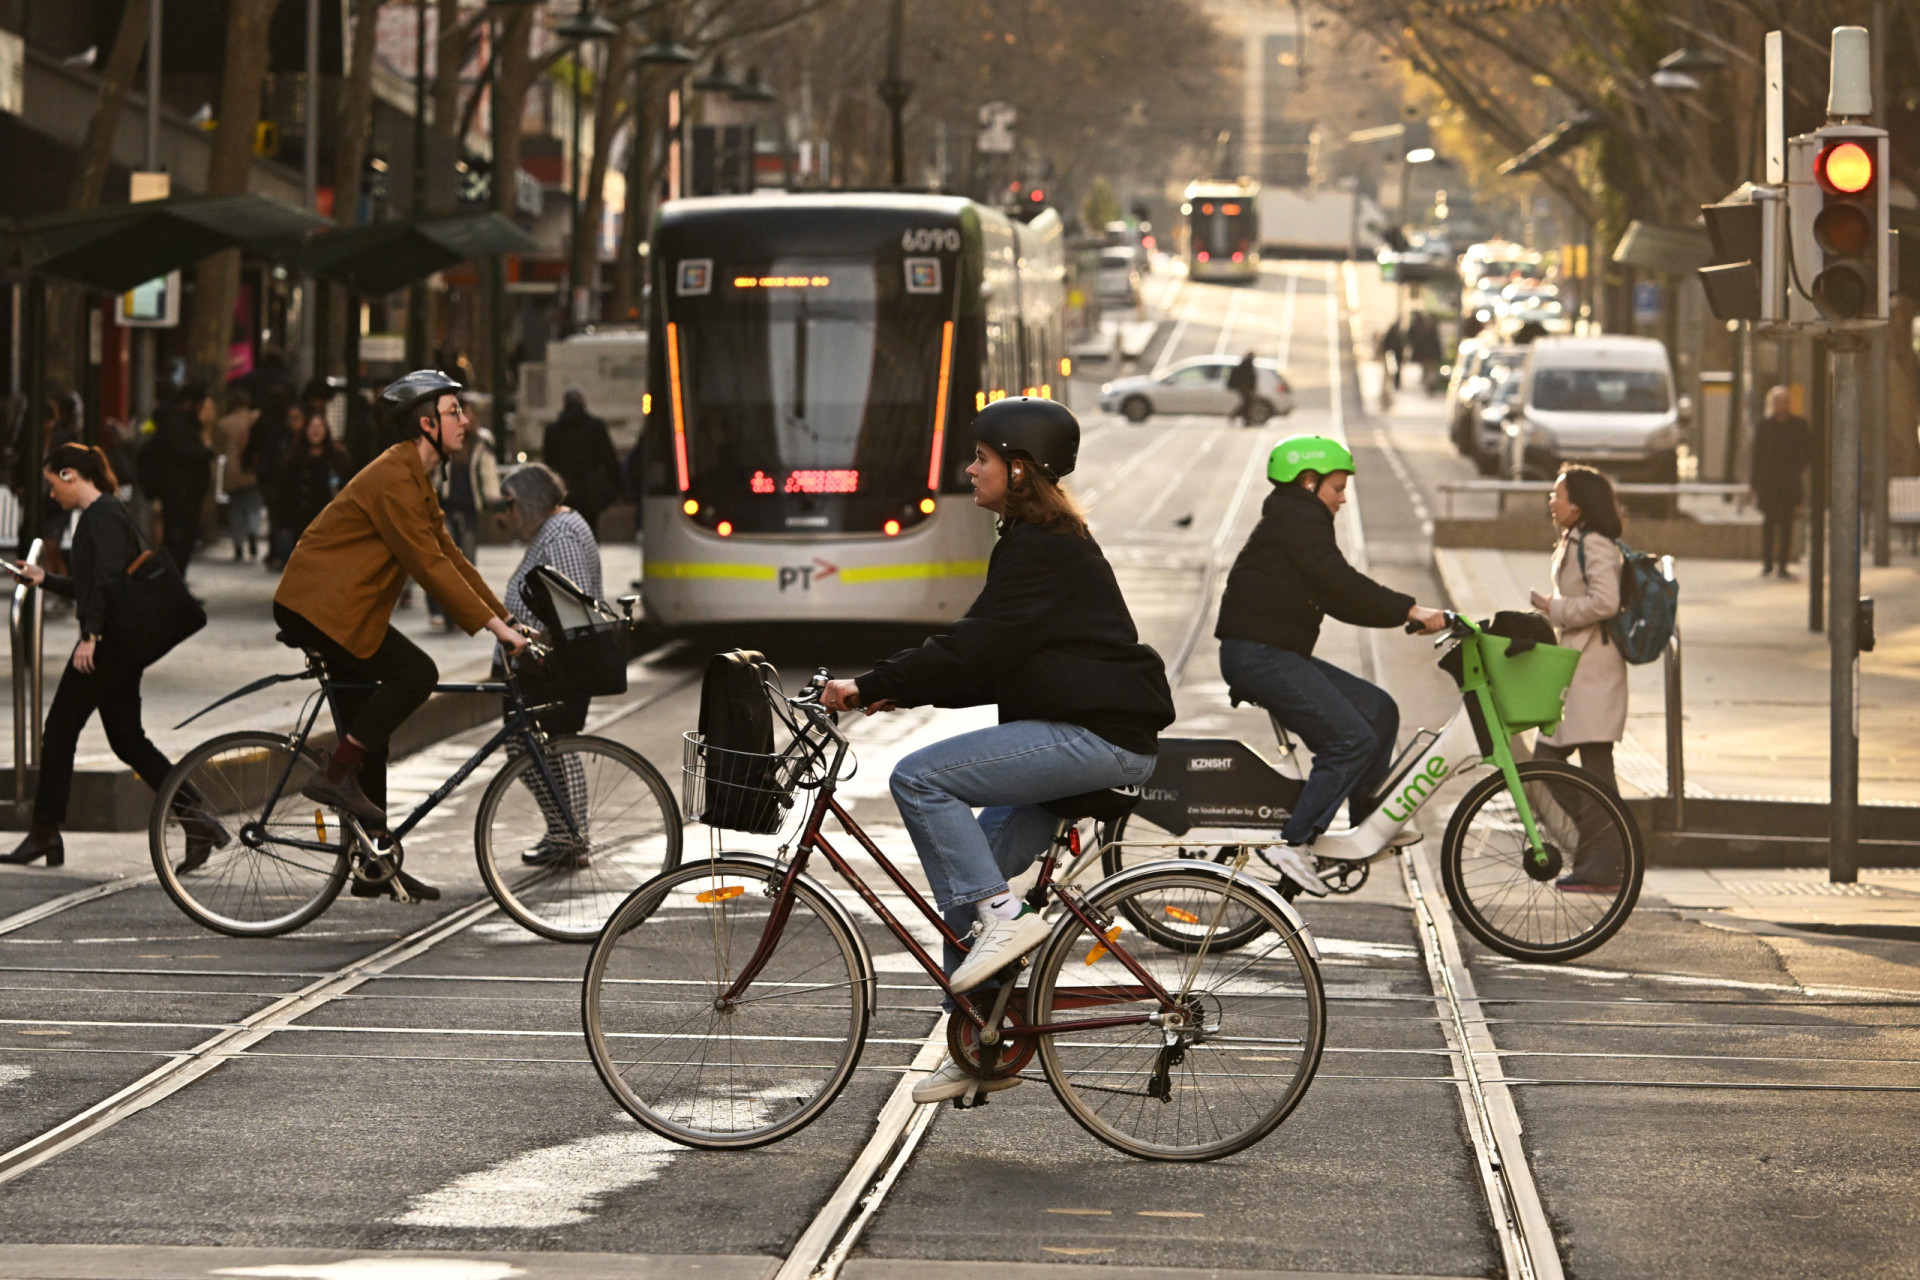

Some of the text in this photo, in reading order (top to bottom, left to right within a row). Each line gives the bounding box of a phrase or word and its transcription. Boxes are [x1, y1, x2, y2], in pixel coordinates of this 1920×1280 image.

[902, 228, 960, 251] 6090
[1190, 757, 1233, 769] KZNSHT
[1141, 786, 1179, 801] Lime
[1382, 756, 1449, 822] Lime
[1187, 806, 1255, 818] I'm looked after by
